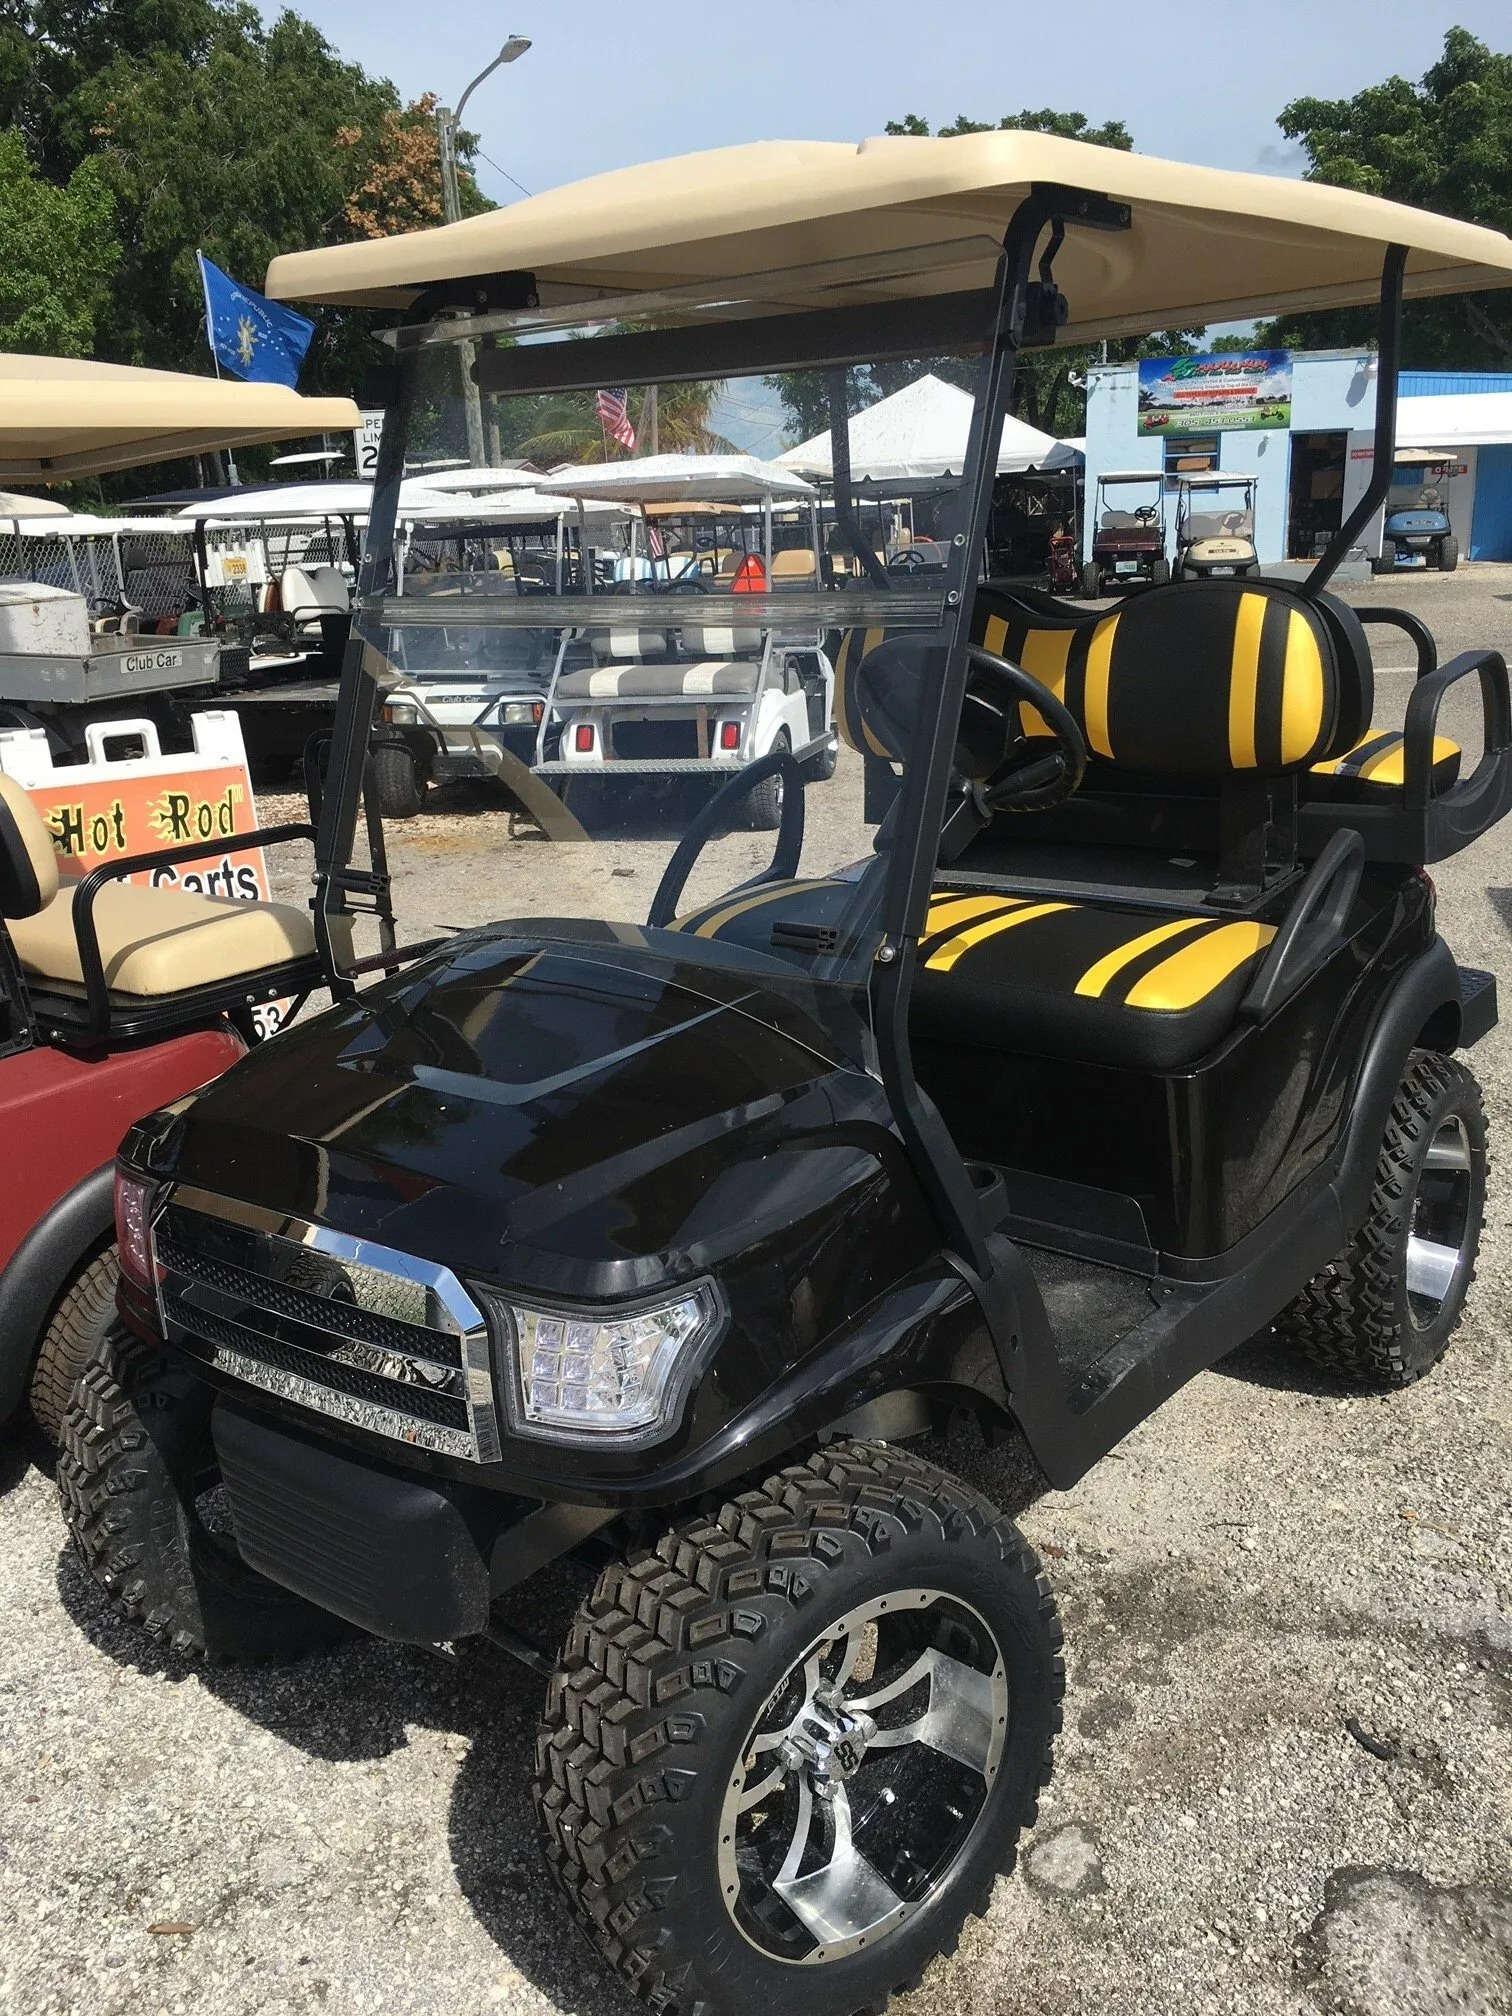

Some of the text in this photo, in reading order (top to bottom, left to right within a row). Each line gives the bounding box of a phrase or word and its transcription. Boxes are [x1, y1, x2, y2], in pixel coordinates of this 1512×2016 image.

[363, 433, 382, 442] LIM
[126, 653, 177, 672] Club Car
[442, 694, 481, 703] Club Car
[48, 787, 236, 856] Hot Rod
